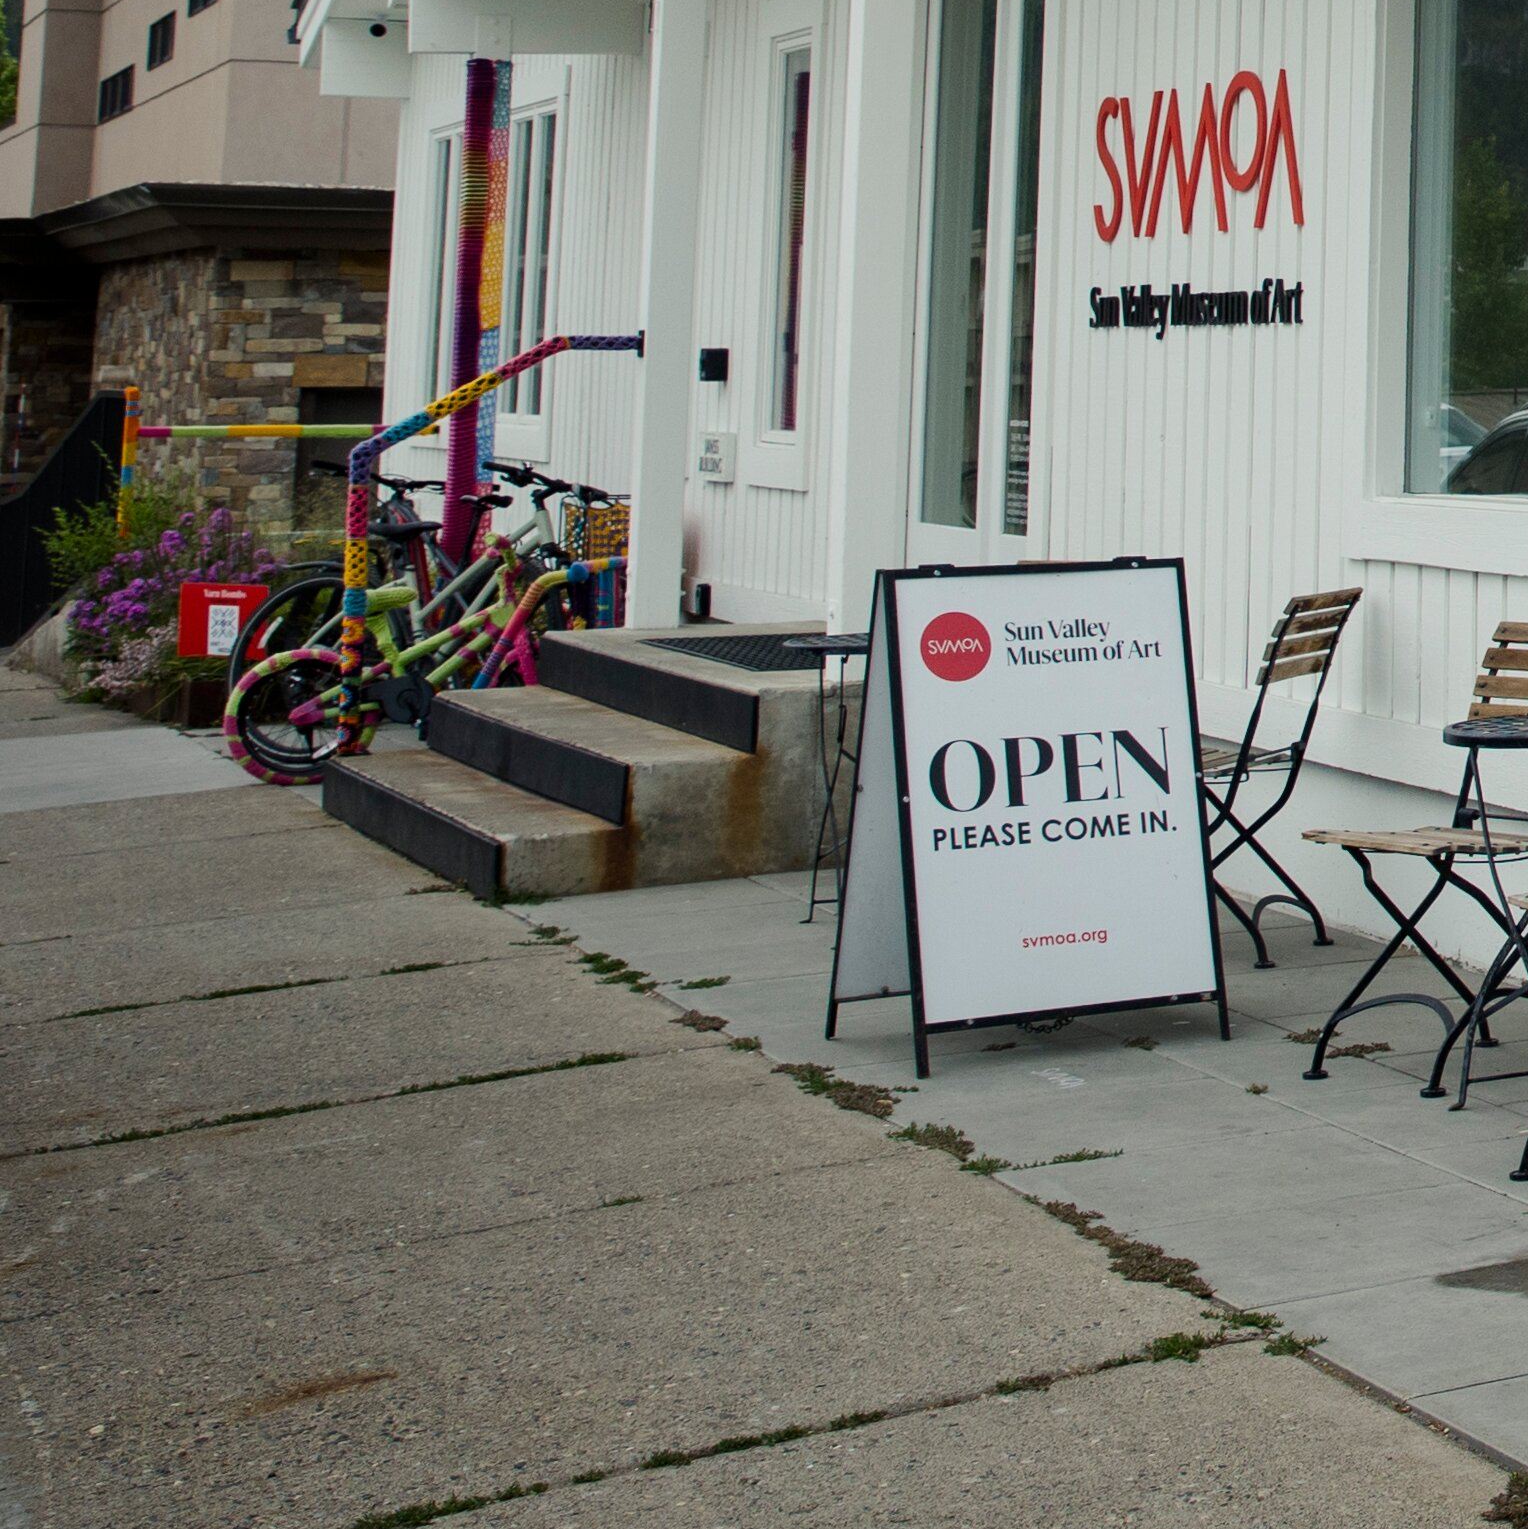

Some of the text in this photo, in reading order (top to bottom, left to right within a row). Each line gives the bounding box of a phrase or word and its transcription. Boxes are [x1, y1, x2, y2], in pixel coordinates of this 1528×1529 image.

[1094, 69, 1304, 242] SVMOA
[1090, 278, 1303, 340] Sun Valley Museum of Art
[928, 637, 984, 655] SVMOA
[1004, 618, 1111, 643] Sun Valley
[1006, 638, 1163, 666] Museum of Art
[928, 726, 1171, 813] OPEN
[932, 809, 1178, 852] PLEASE COME IN.
[1021, 928, 1109, 949] svmoa.org
